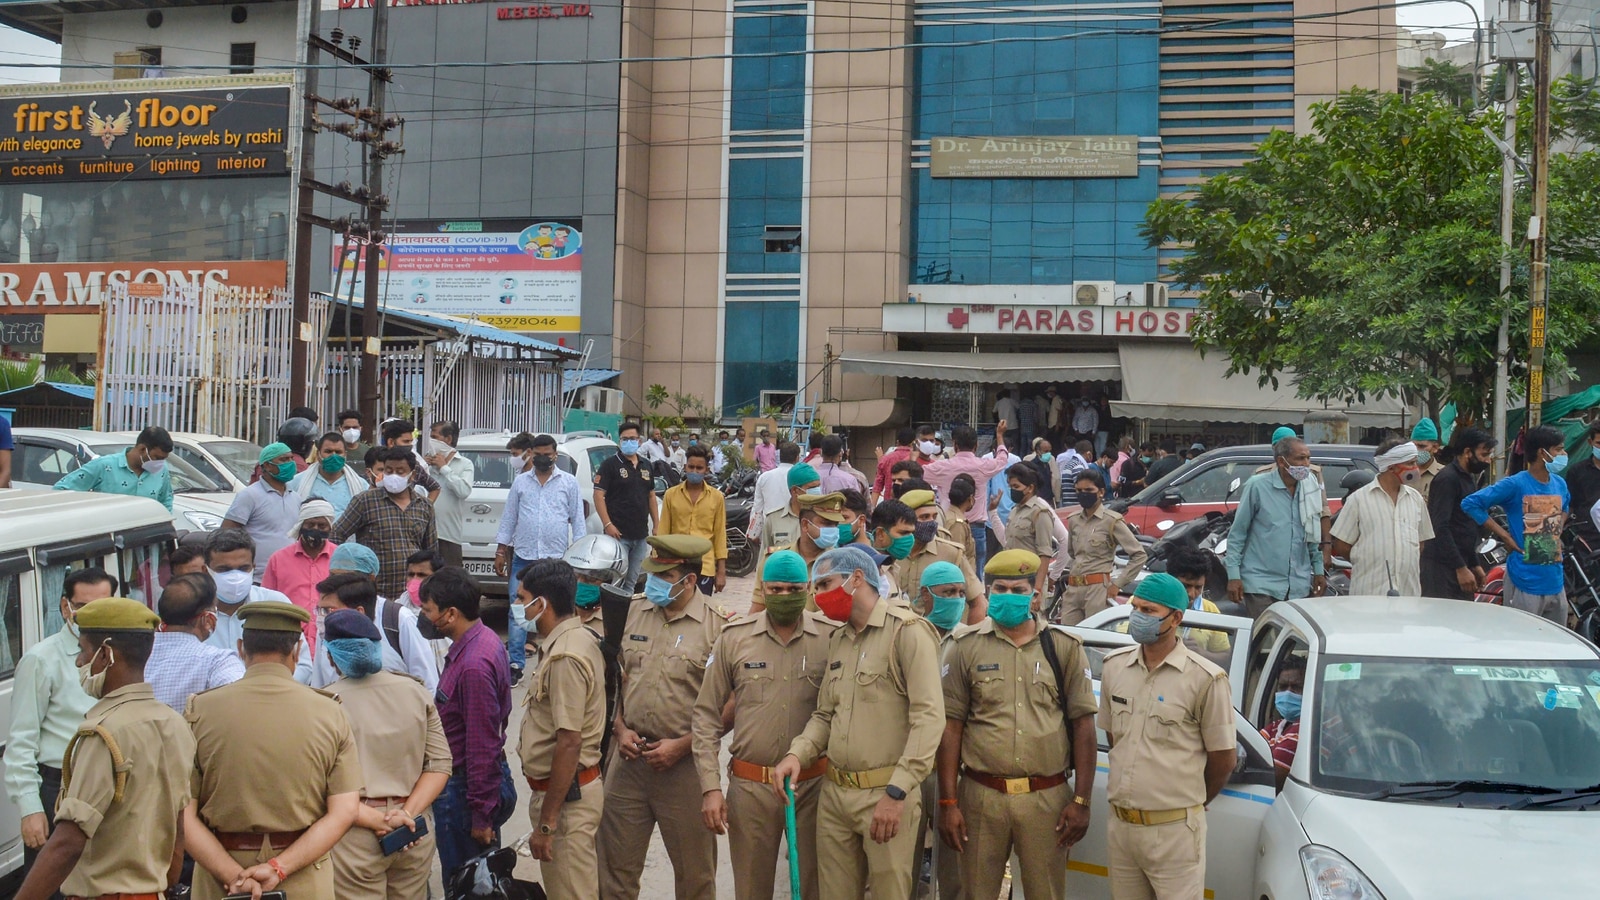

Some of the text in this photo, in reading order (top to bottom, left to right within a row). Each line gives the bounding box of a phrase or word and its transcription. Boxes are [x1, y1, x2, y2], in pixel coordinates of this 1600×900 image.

[13, 98, 217, 132] first floor
[23, 136, 82, 154] elegance
[134, 128, 282, 149] home jewels by rashi
[938, 138, 1131, 155] Dr. Arinjay Jain
[11, 156, 266, 177] accents furniture lighting interior
[455, 236, 508, 244] (COVID-19)
[971, 304, 995, 313] SHRI
[998, 308, 1094, 332] PARAS
[1485, 667, 1543, 680] INDIA
